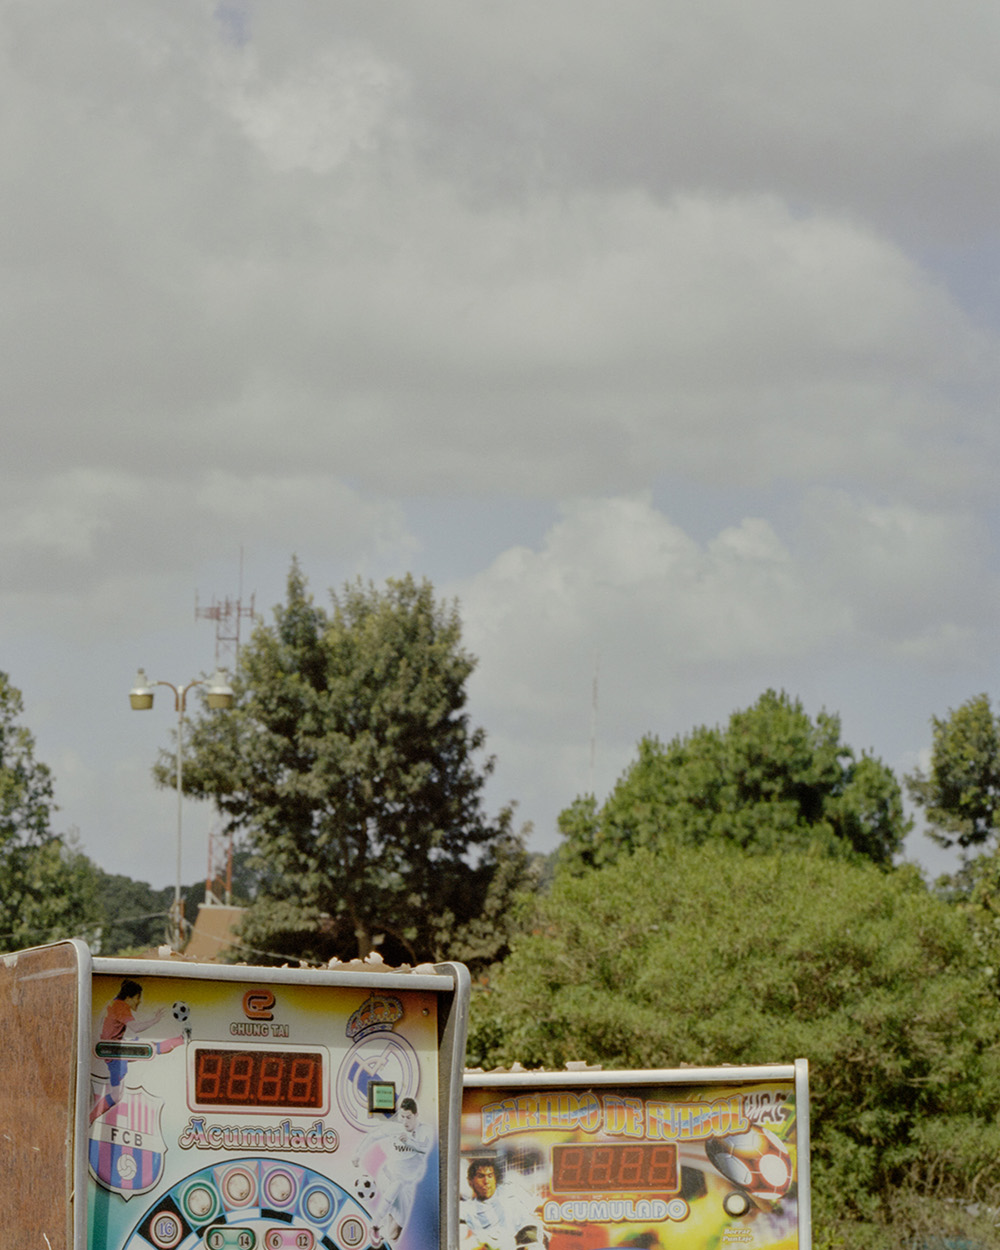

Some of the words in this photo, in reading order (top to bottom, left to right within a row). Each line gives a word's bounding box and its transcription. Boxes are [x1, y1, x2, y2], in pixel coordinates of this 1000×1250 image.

[230, 1022, 269, 1036] CHUNG
[271, 1024, 289, 1038] TAI
[482, 1094, 601, 1143] PARTIDO
[603, 1096, 644, 1137] DE
[646, 1096, 750, 1142] FUTBOL
[178, 1116, 340, 1153] Acumulado
[545, 1200, 689, 1221] ACUMULADO
[160, 1223, 173, 1237] 16
[349, 1226, 356, 1241] 1
[723, 1227, 750, 1236] Borrar
[214, 1235, 220, 1246] 1
[240, 1236, 250, 1246] 14
[273, 1236, 279, 1246] 6
[299, 1236, 308, 1246] 12
[722, 1235, 753, 1243] Puntaje
